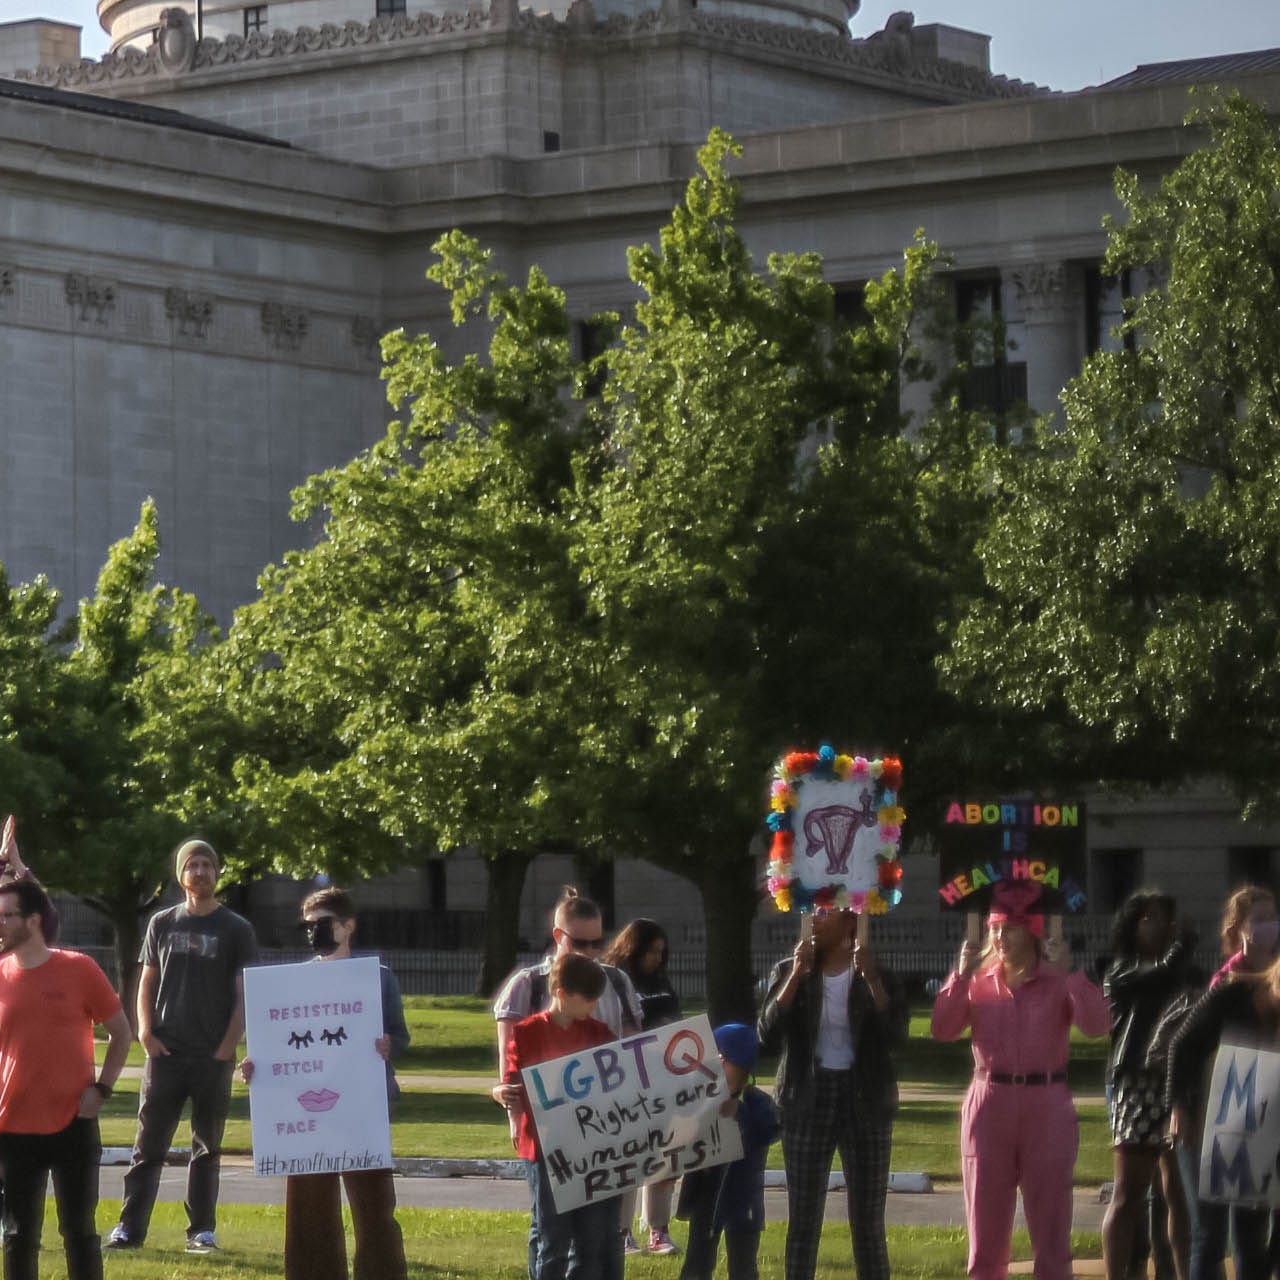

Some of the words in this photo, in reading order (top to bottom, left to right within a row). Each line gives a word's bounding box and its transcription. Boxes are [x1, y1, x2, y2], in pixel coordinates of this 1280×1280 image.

[268, 1000, 364, 1022] RESISTING
[272, 1059, 324, 1077] BITCH
[530, 1029, 718, 1112] LGBTQ
[575, 1091, 667, 1139] Rights
[675, 1080, 721, 1108] are
[276, 1119, 318, 1136] FACE
